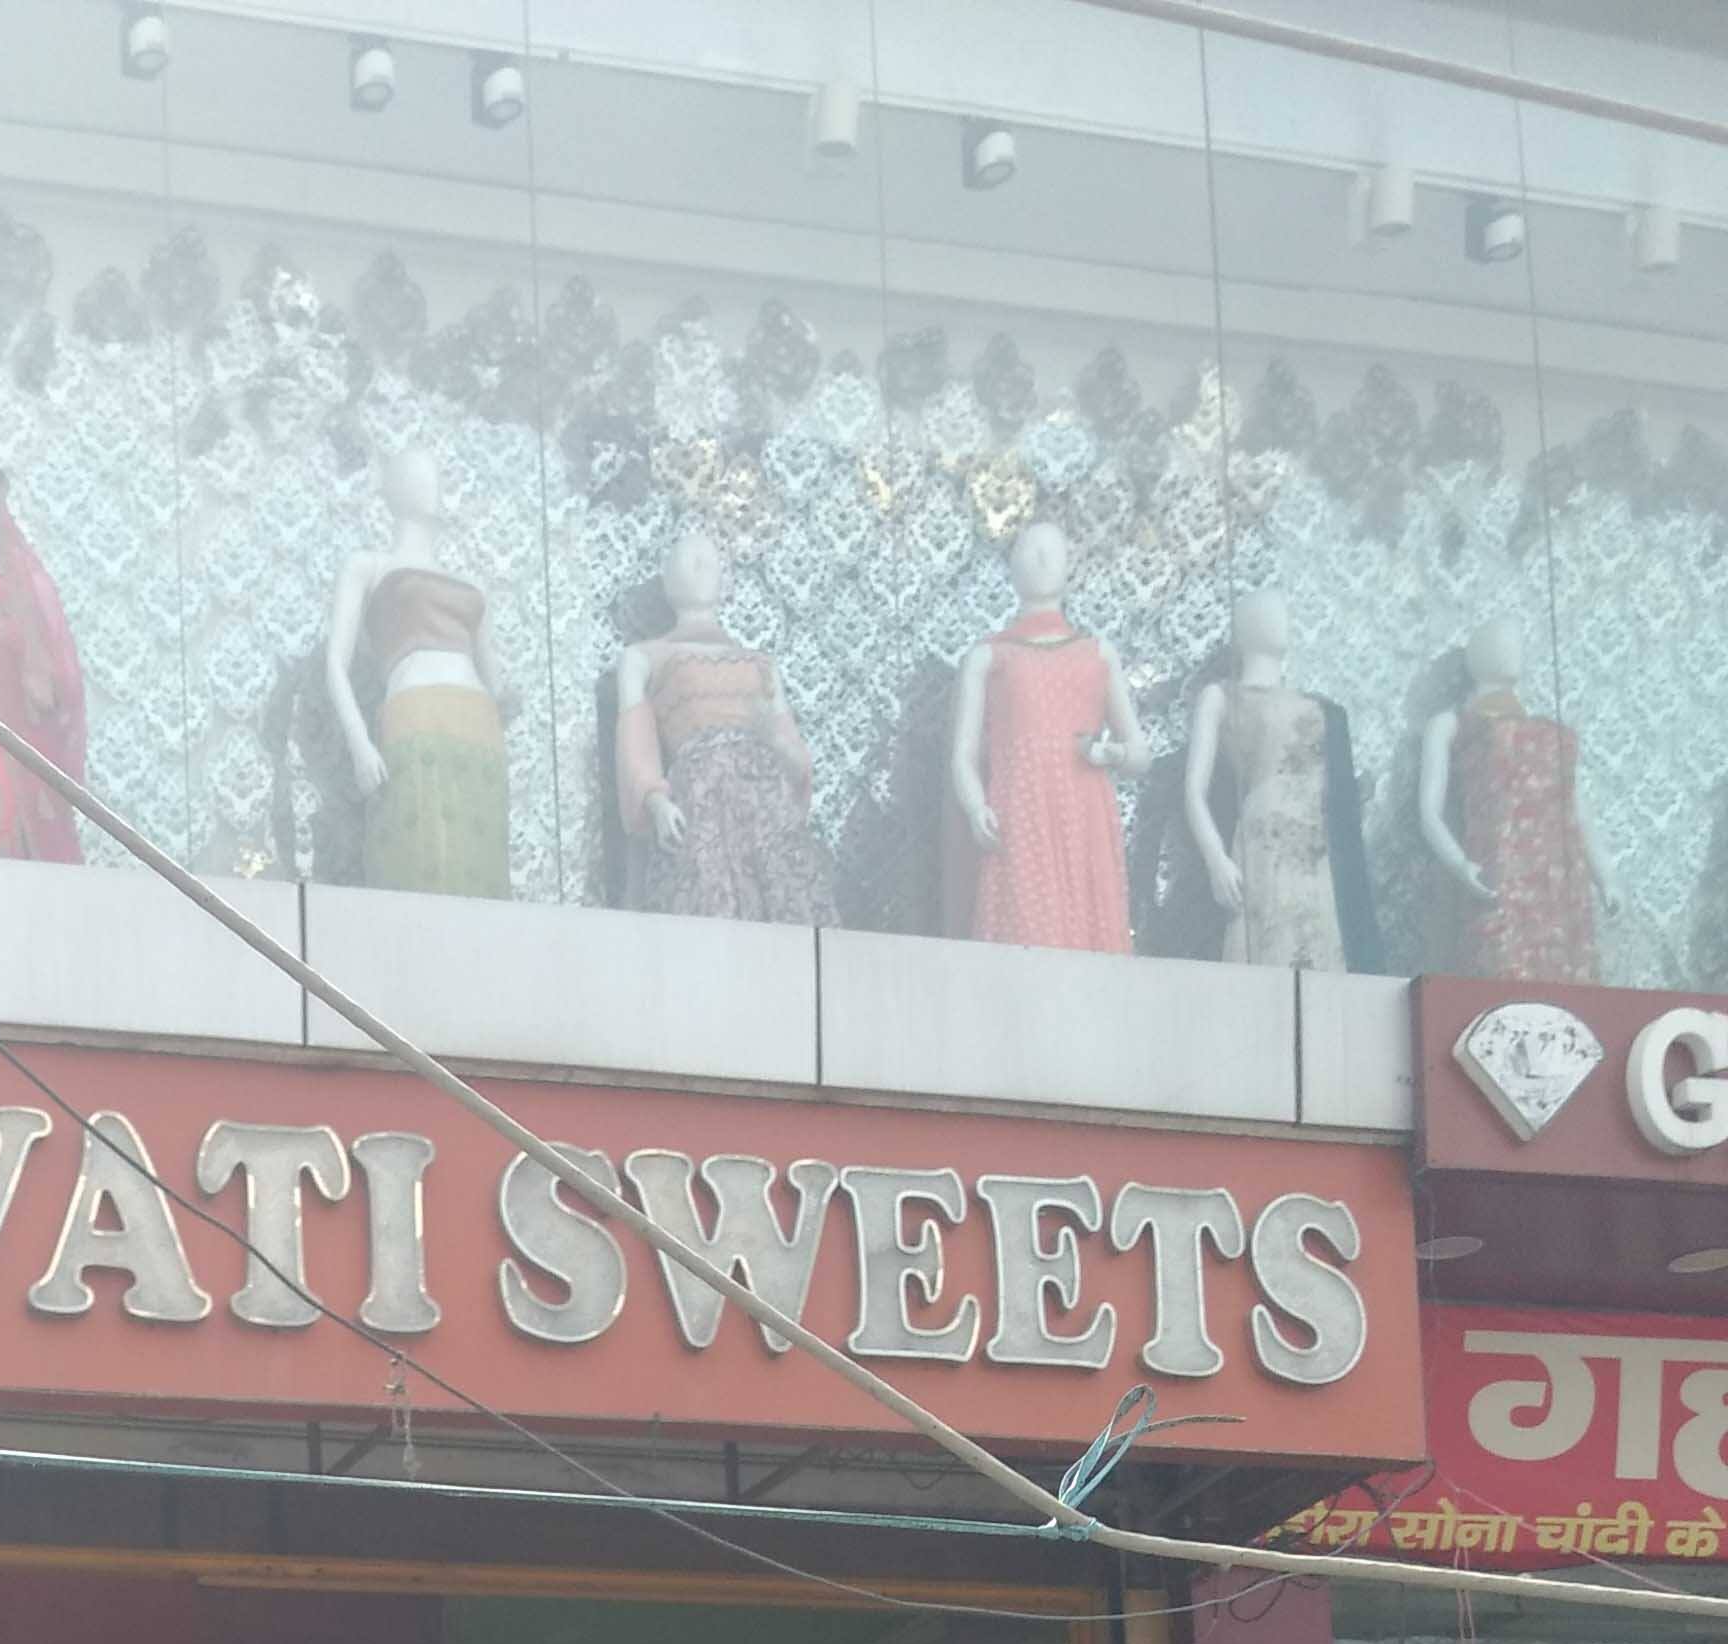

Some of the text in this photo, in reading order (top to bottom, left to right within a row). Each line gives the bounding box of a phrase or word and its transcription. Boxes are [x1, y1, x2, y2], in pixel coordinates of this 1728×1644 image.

[499, 1143, 1366, 1385] SWEETS
[1390, 1498, 1522, 1552] सोना
[1536, 1501, 1654, 1554] चांदी
[1666, 1506, 1726, 1557] के
